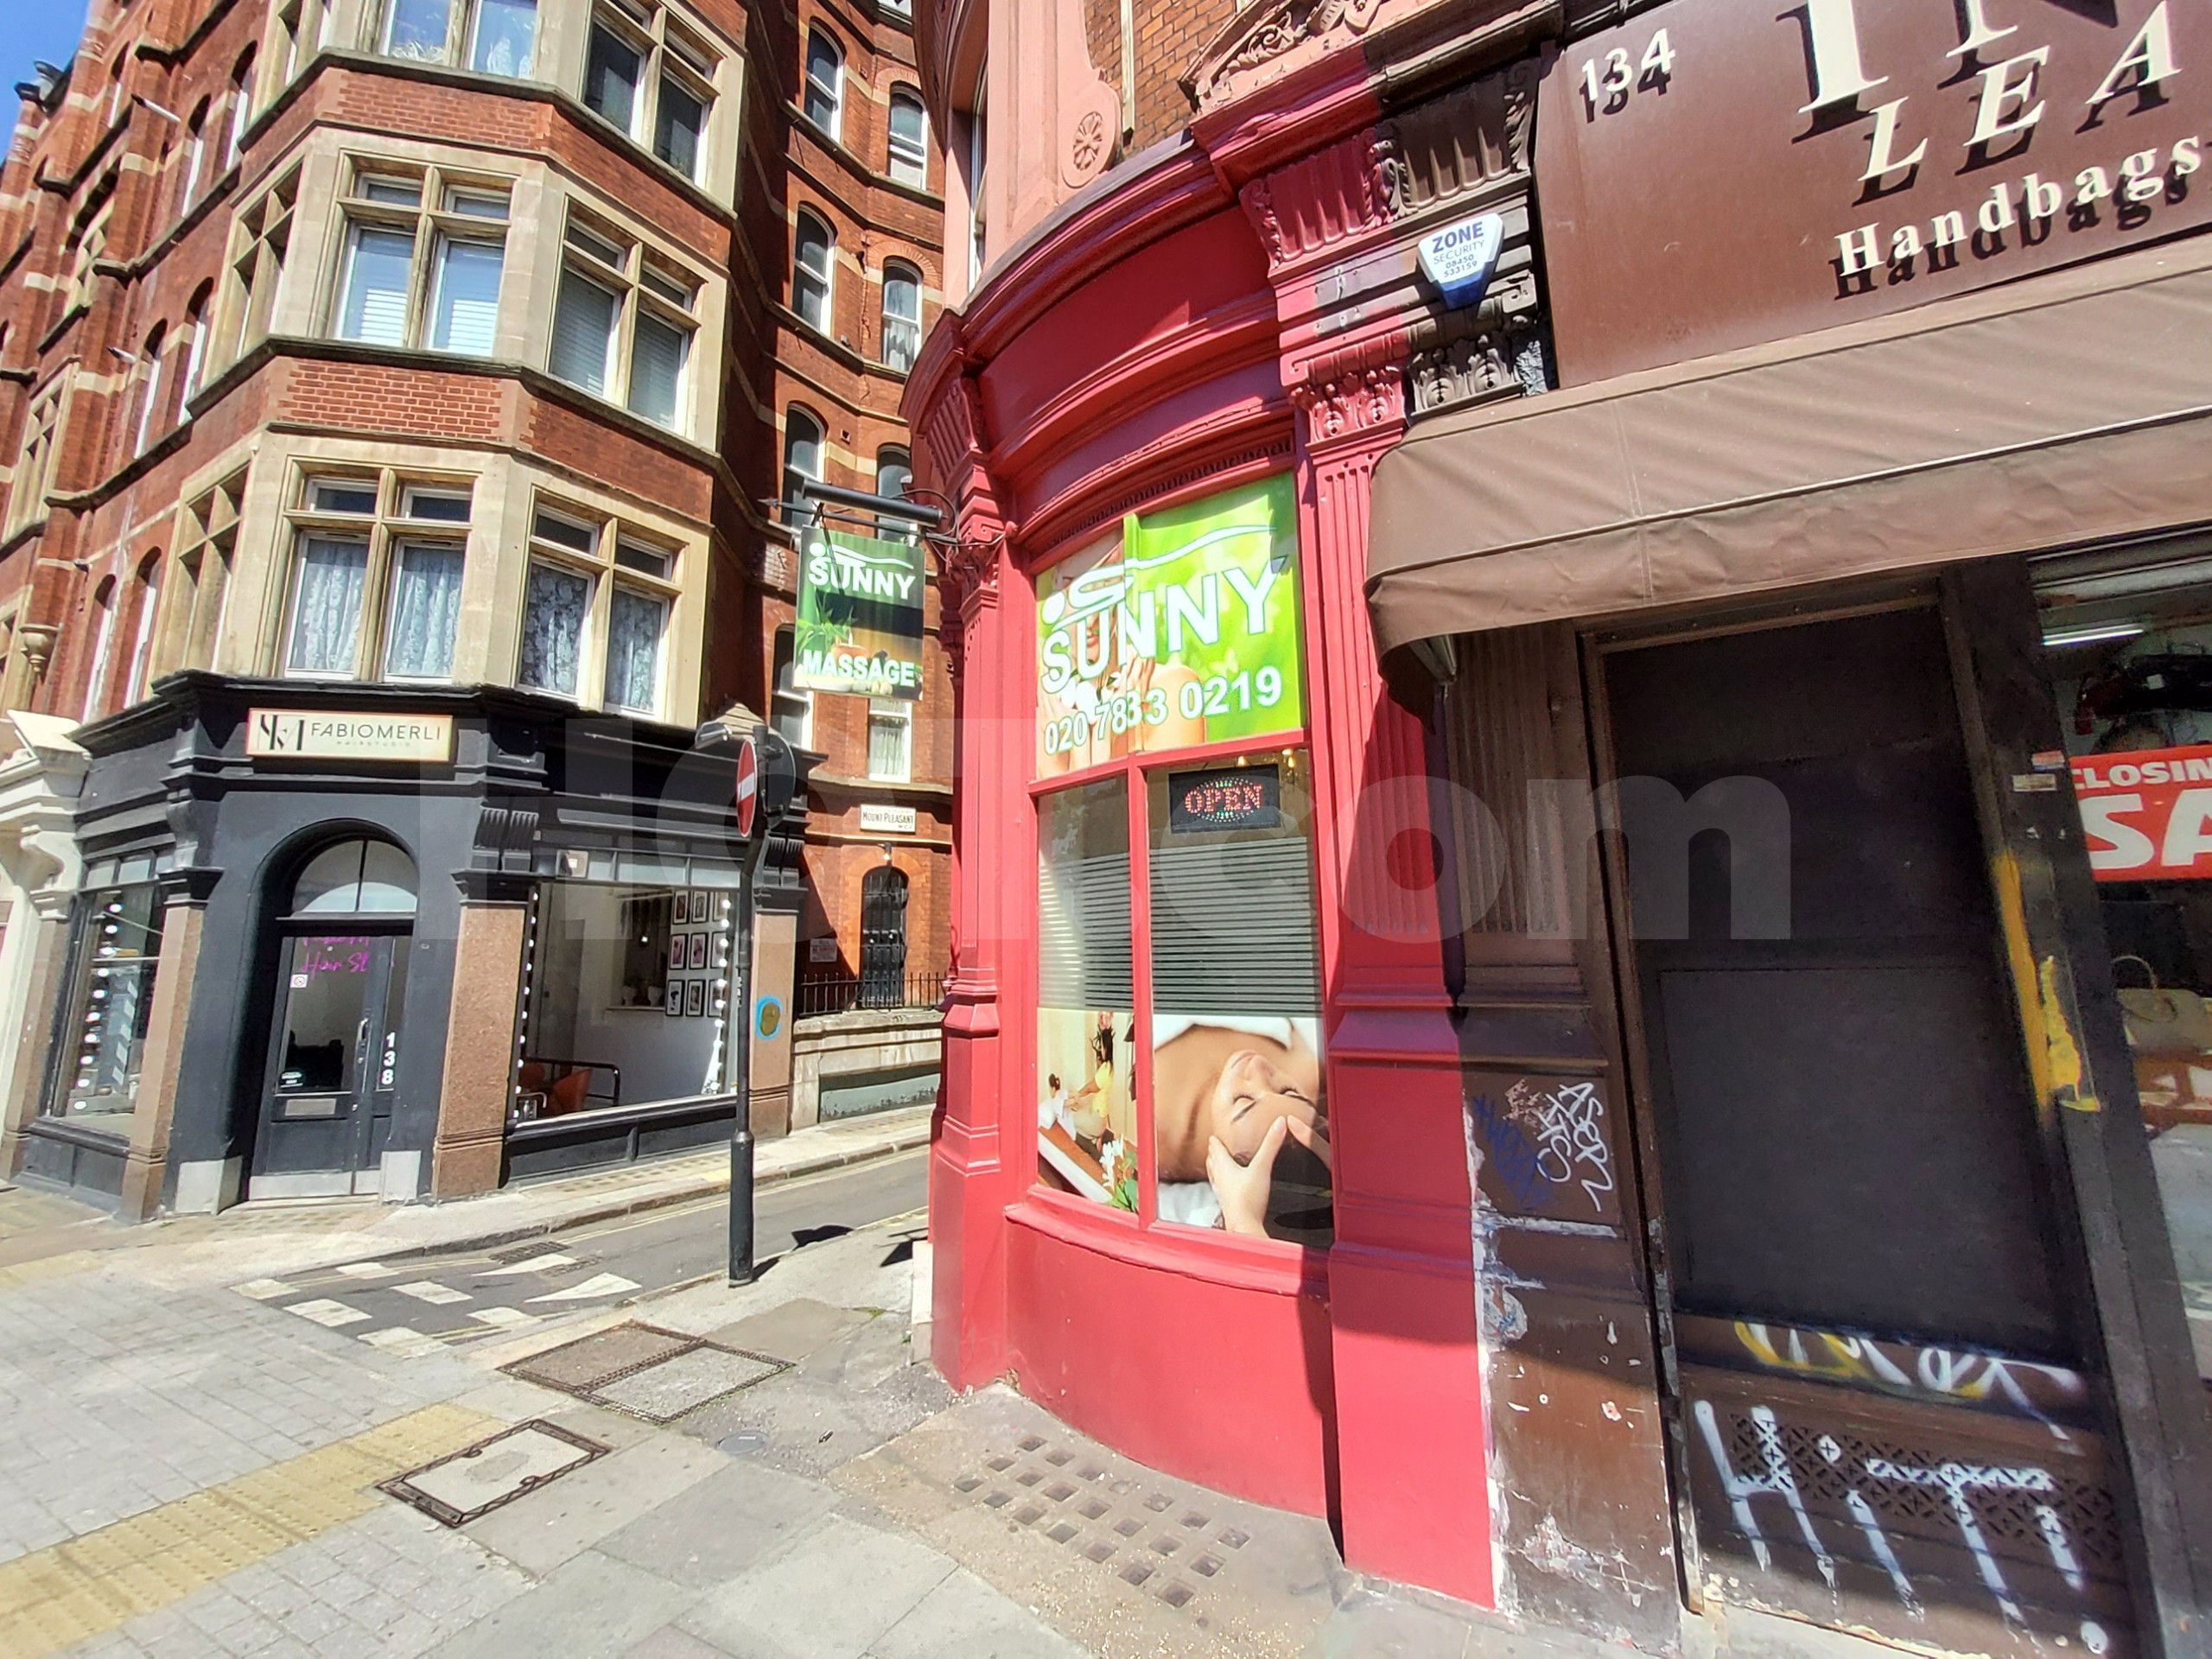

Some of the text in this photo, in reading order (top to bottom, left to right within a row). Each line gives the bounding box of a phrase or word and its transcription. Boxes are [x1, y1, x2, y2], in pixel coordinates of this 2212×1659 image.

[1582, 28, 1676, 101] 134
[1834, 136, 2202, 276] Handbags
[1433, 221, 1484, 253] ZONE
[1433, 240, 1484, 264] SECURITY
[808, 556, 916, 600] SUNNY
[1041, 556, 1287, 694] SUNNY
[803, 649, 916, 688] MASSAGE
[1045, 711, 1088, 755] 020
[1179, 665, 1283, 720] 0219
[311, 723, 441, 741] FABIOMERLI
[863, 811, 913, 823] MOUNT PLEASANT
[1185, 784, 1262, 814] OPEN
